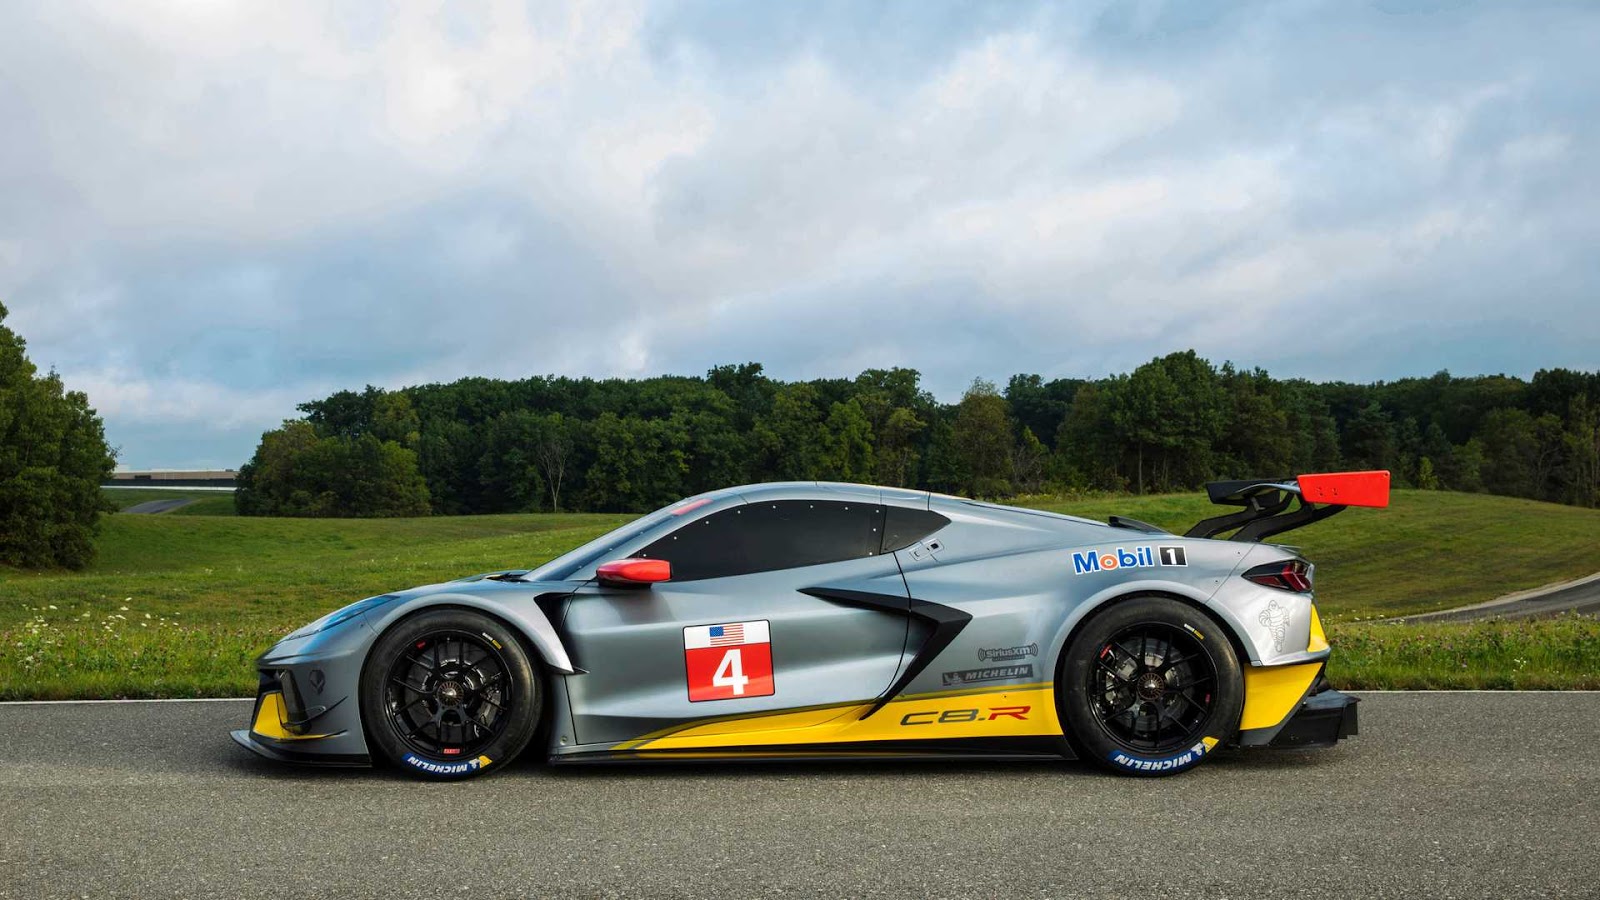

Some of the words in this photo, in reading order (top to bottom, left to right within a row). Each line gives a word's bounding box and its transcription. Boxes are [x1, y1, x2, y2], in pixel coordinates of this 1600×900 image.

[1072, 546, 1154, 575] Mobil
[712, 648, 749, 696] 4
[965, 666, 1029, 681] MICHELIN
[900, 706, 1031, 725] C8.R
[407, 755, 468, 774] MICHELIN
[1114, 752, 1192, 771] MICHELIN
